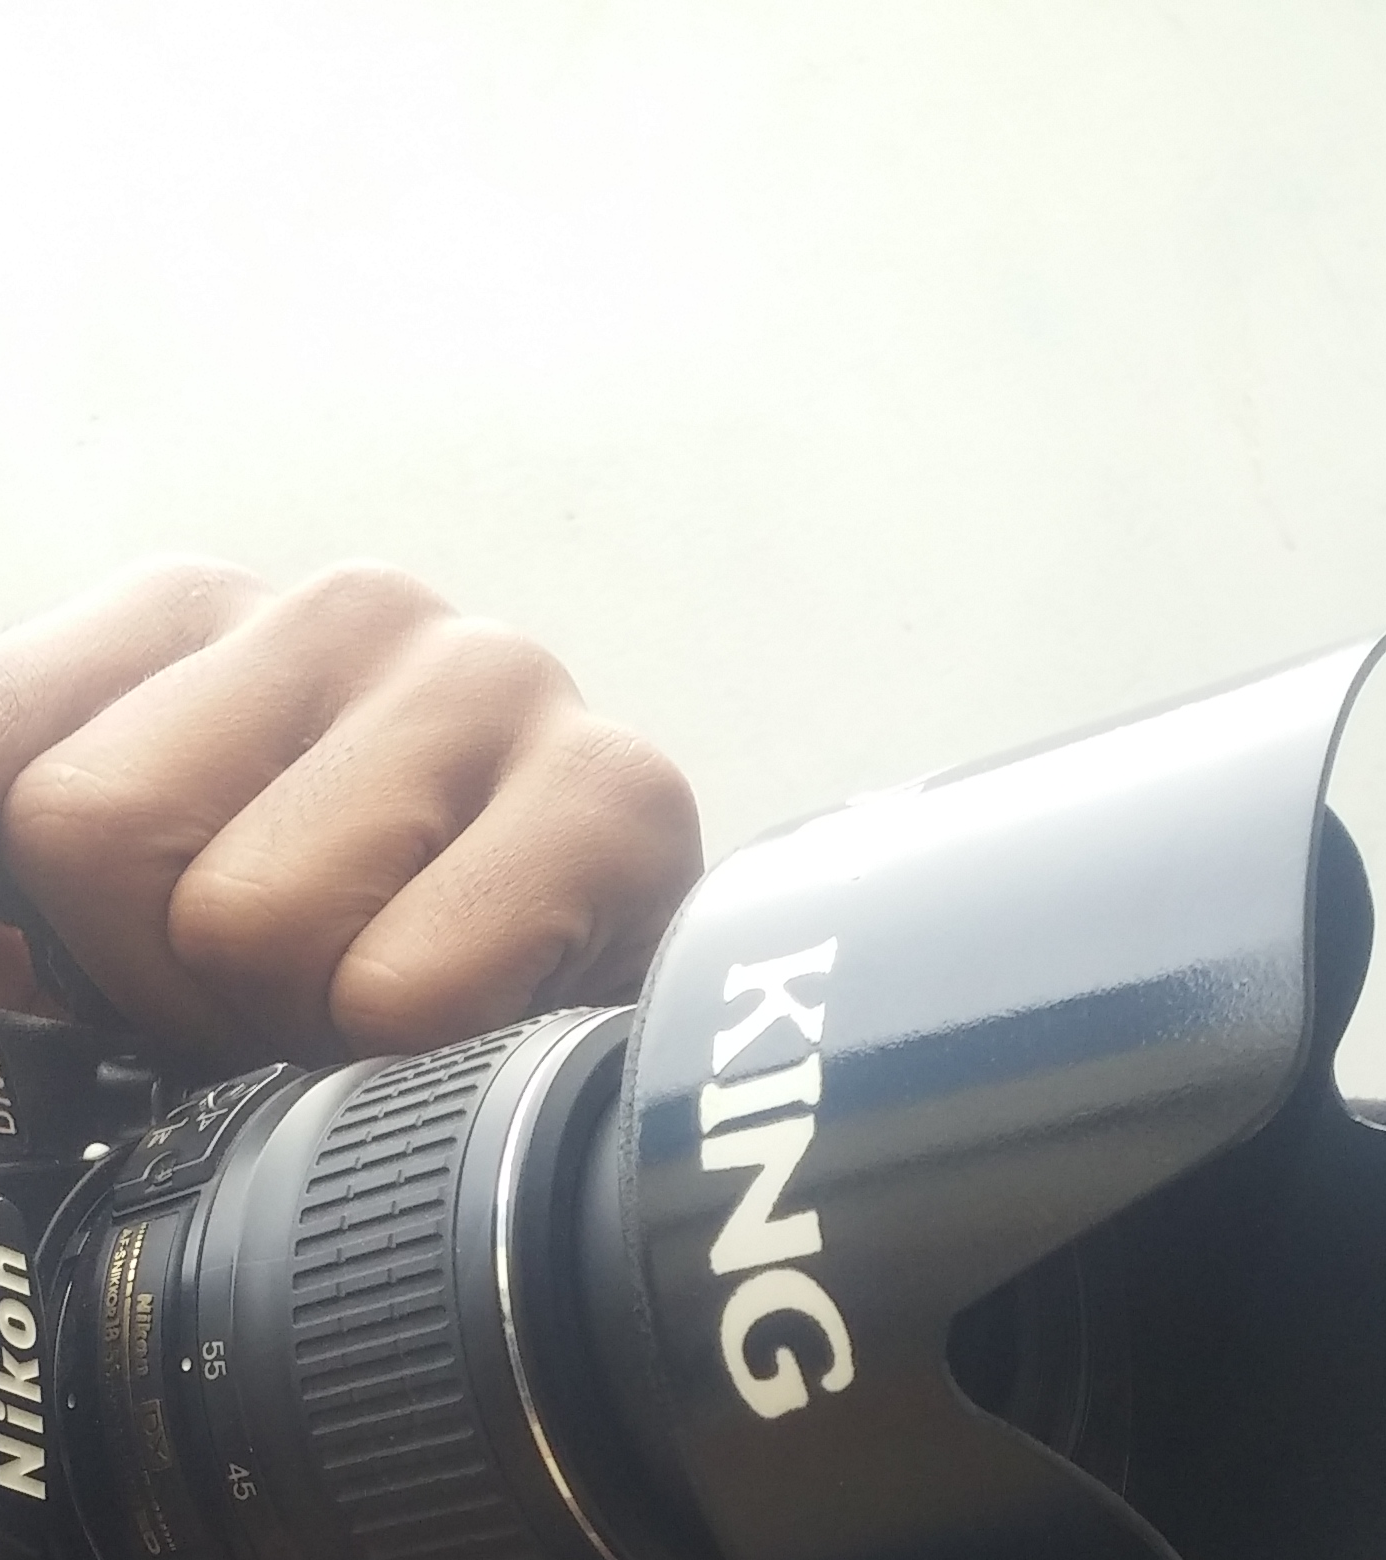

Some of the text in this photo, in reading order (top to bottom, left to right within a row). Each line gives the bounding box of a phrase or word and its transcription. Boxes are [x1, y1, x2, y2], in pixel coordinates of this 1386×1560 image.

[700, 935, 857, 1420] KING
[134, 1292, 154, 1378] Nikon
[201, 1339, 226, 1382] 55
[226, 1460, 256, 1503] 45
